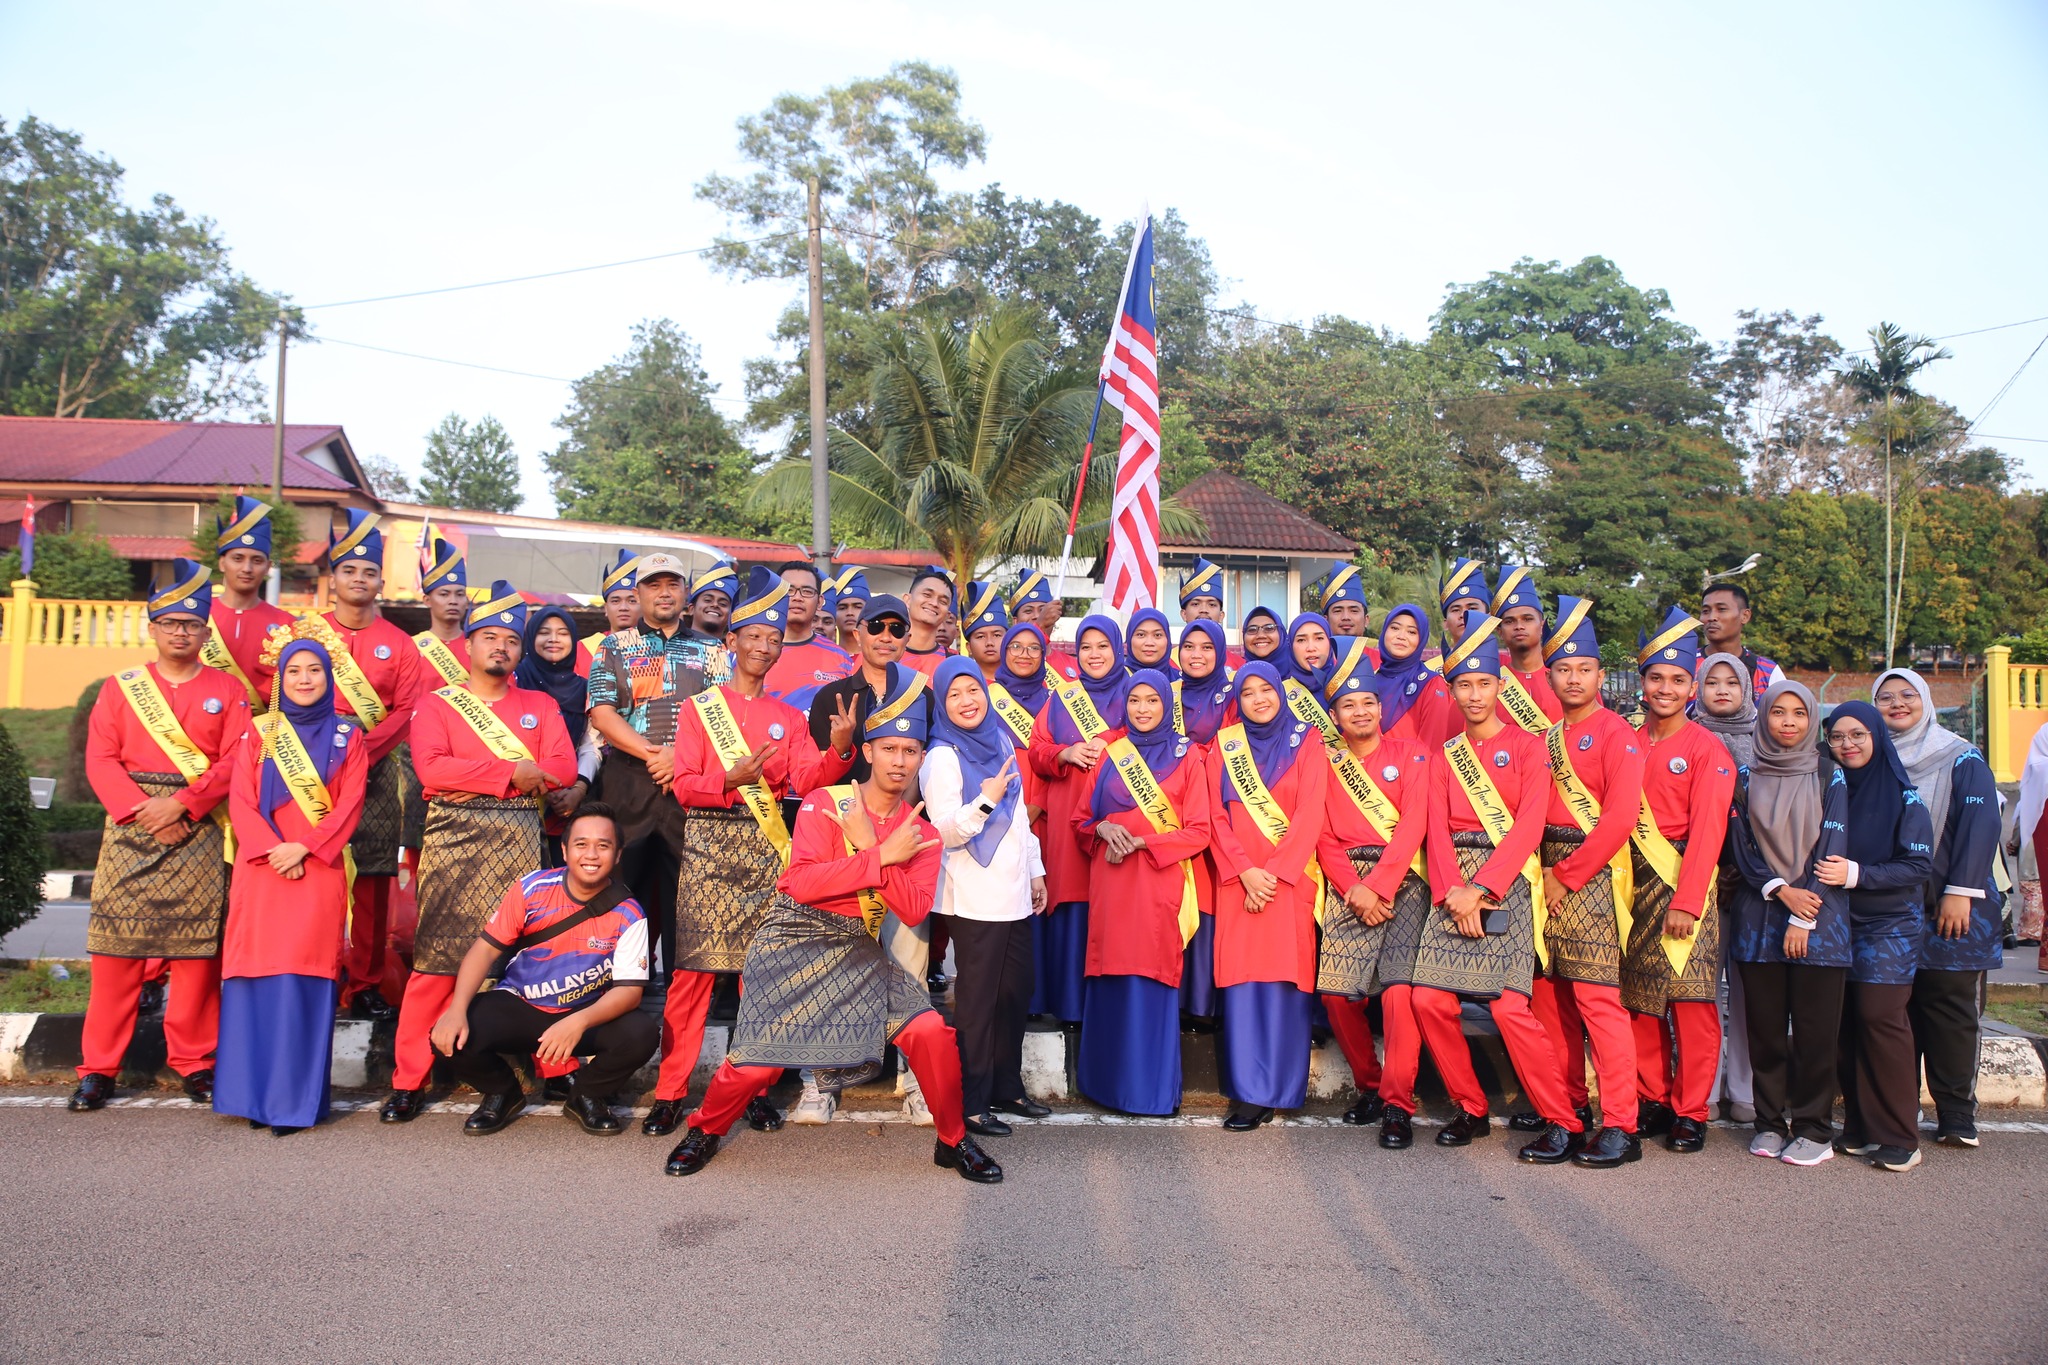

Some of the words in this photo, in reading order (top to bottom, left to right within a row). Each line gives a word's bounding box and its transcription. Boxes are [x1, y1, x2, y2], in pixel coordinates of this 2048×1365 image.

[429, 649, 456, 680] MADANI
[435, 645, 461, 675] MALAYSIA
[129, 683, 158, 724] MADANI
[139, 680, 165, 719] MALAYSIA
[359, 696, 380, 726] Merd
[451, 696, 488, 732] MADANI
[458, 692, 494, 727] MALAYSIA
[1070, 700, 1094, 733] MADANI
[1077, 696, 1100, 728] MALAYSIA
[1302, 696, 1329, 731] MALAYSIA
[1501, 689, 1533, 726] MADANI
[1508, 685, 1537, 720] MALAYSIA
[703, 706, 730, 751] MADANI
[713, 703, 737, 746] MALAYSIA
[1006, 712, 1031, 740] MADA
[1012, 708, 1033, 730] MALAY
[280, 732, 306, 773] MALAYSIA
[1450, 749, 1476, 788] MADANI
[1458, 744, 1481, 782] MALAYSIA
[291, 777, 318, 802] Jiwa
[1125, 767, 1152, 806] MADANI
[1134, 763, 1157, 800] MALAYSIA
[1230, 756, 1253, 797] MADANI
[1239, 754, 1258, 792] MALAYSIA
[1339, 764, 1367, 802] MADANI
[1345, 759, 1372, 796] MALAYSIA
[1556, 770, 1572, 794] Jiwa
[1248, 795, 1269, 817] Jiwa
[1362, 798, 1384, 820] Jiwa
[1470, 784, 1492, 806] Jiwa
[1966, 796, 1984, 804] IPK
[1147, 803, 1169, 825] Jiwa
[1823, 820, 1845, 833] MPK
[1910, 842, 1930, 854] MPK
[523, 957, 614, 1000] MALAYSIA
